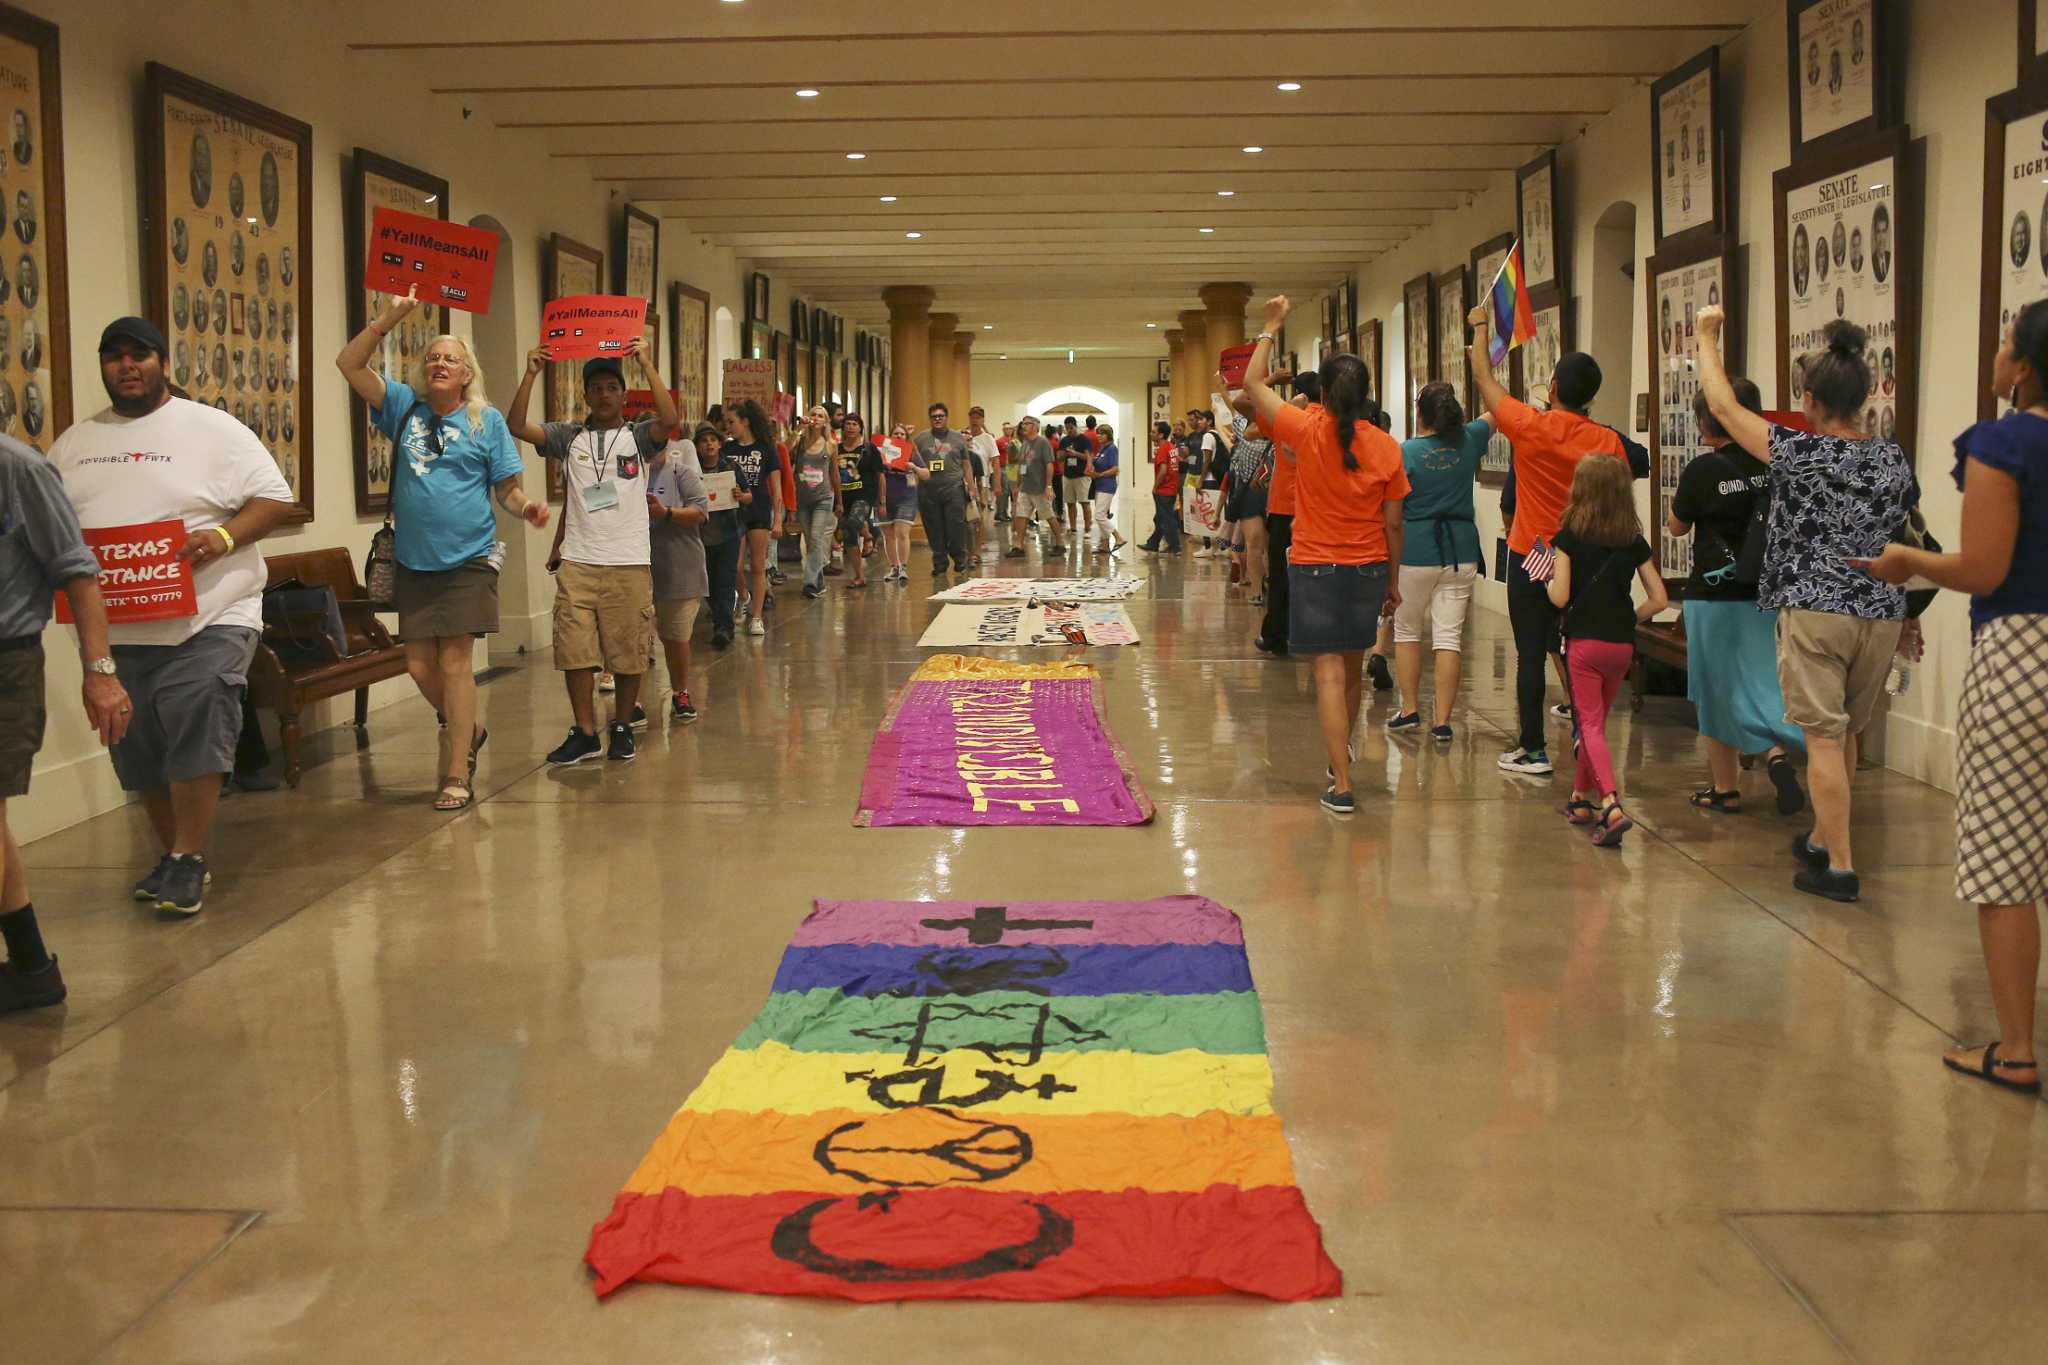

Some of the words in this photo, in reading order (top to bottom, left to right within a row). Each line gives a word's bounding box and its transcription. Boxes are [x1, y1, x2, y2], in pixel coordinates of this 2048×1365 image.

[1818, 174, 1858, 203] SENATE
[1842, 184, 1892, 209] LEGISLATURE
[381, 227, 489, 262] #YallMeansAll
[449, 287, 466, 297] ACLU
[547, 307, 638, 322] #YallMeansAll
[144, 455, 173, 463] FWTX
[99, 538, 172, 560] TEXAS
[98, 562, 181, 585] STANCE
[132, 595, 149, 605] TO
[151, 591, 182, 603] 97779
